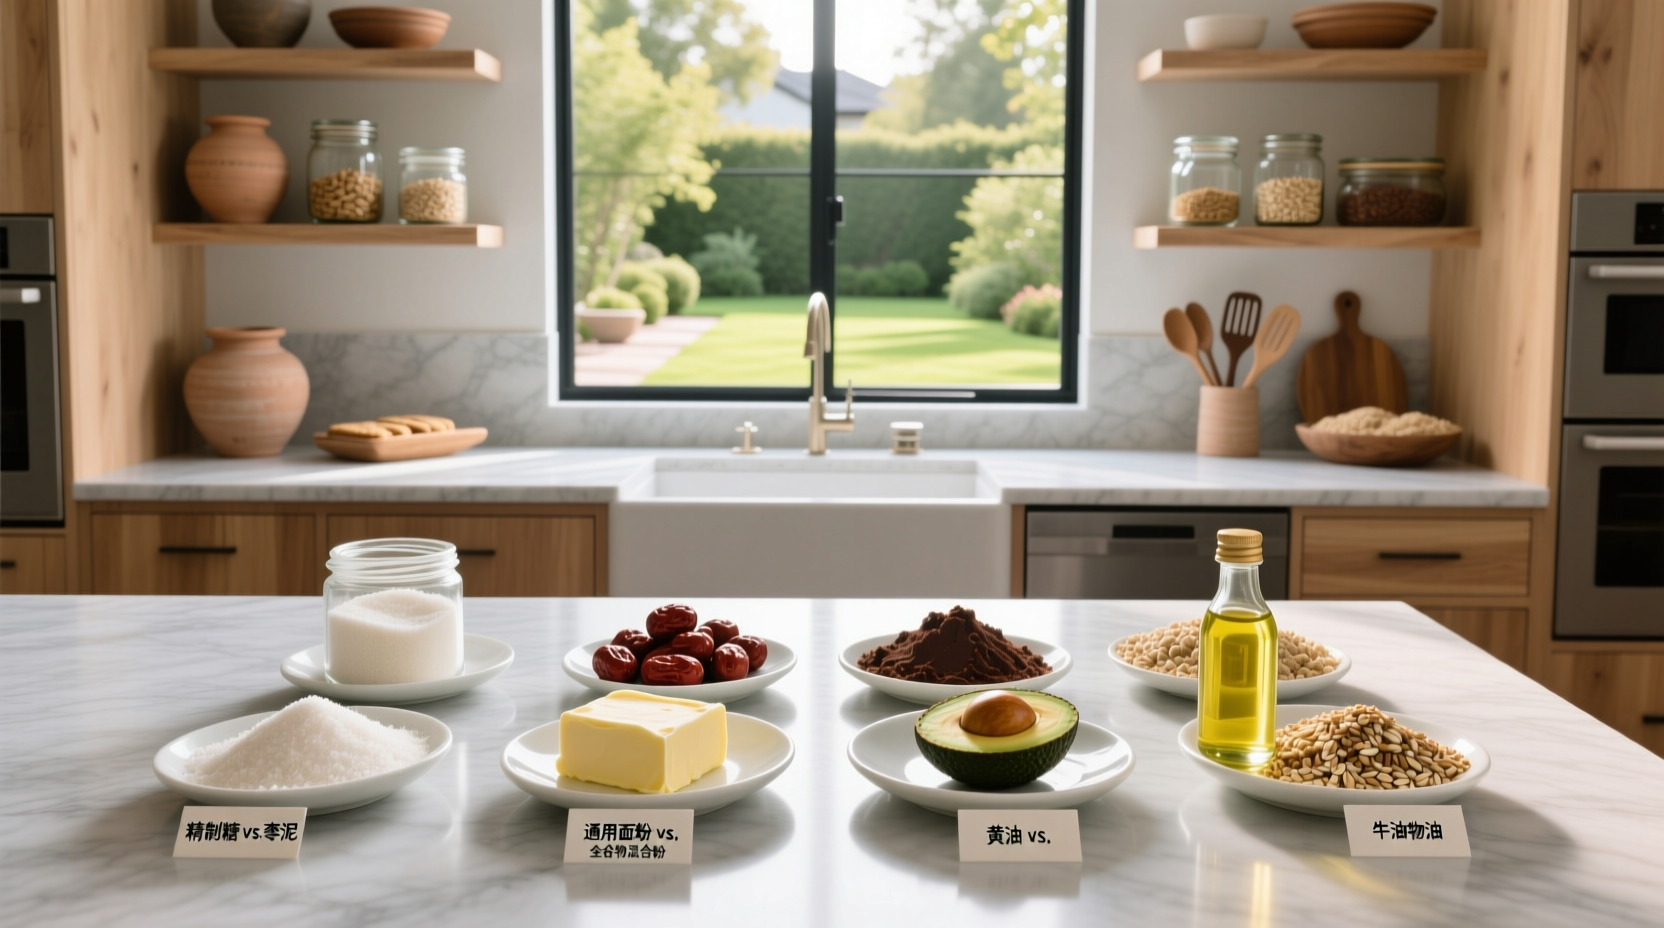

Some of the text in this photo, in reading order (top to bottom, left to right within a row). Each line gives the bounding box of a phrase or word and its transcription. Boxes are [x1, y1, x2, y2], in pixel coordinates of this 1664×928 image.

[185, 821, 241, 842] 精制糖
[583, 822, 652, 842] 通用面粉
[986, 824, 1023, 846] 黄油
